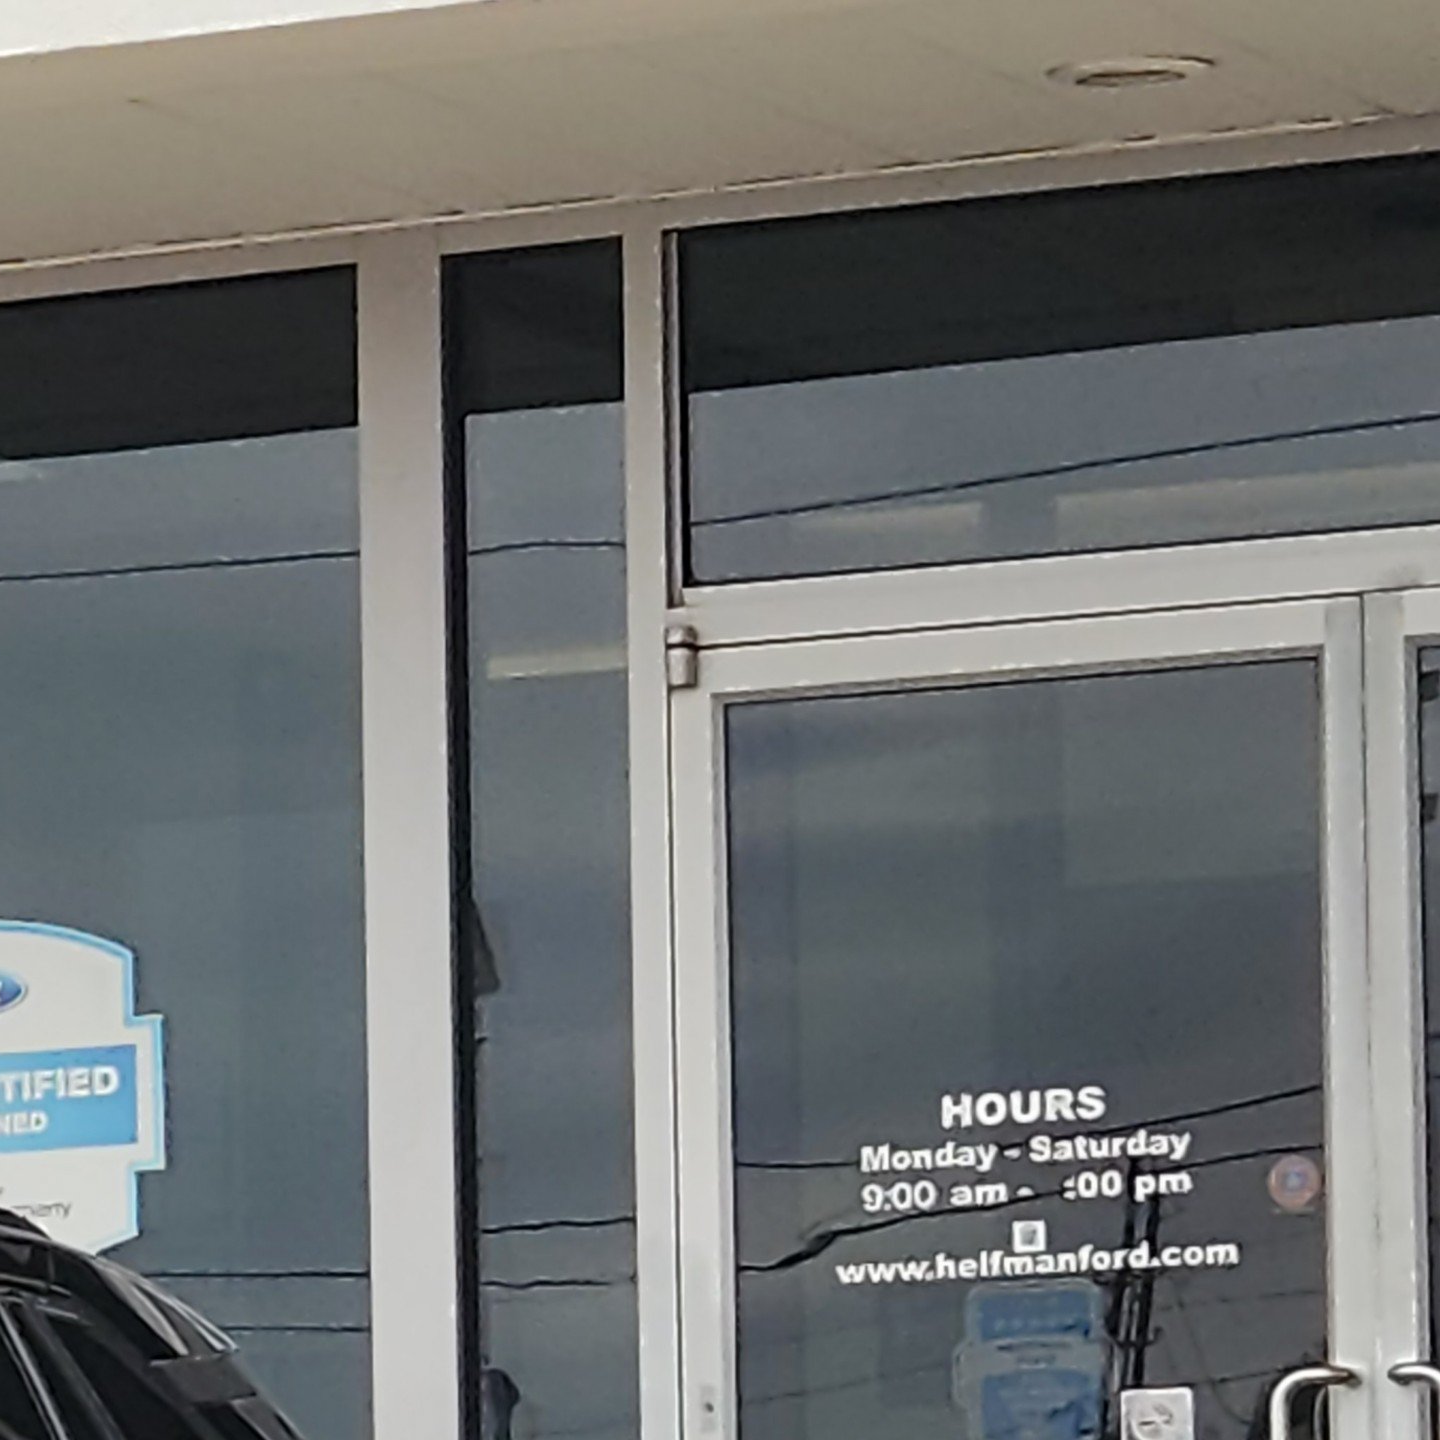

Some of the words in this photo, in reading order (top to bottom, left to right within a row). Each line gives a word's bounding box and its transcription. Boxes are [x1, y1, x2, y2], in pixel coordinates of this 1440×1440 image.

[941, 1086, 1106, 1129] HOURS
[860, 1141, 997, 1172] Monday
[1029, 1128, 1191, 1162] Saturday
[861, 1180, 937, 1212] 9:00
[950, 1182, 1009, 1206] am
[1134, 1171, 1192, 1202] pm
[836, 1239, 1239, 1284] www.helfmanford.com
